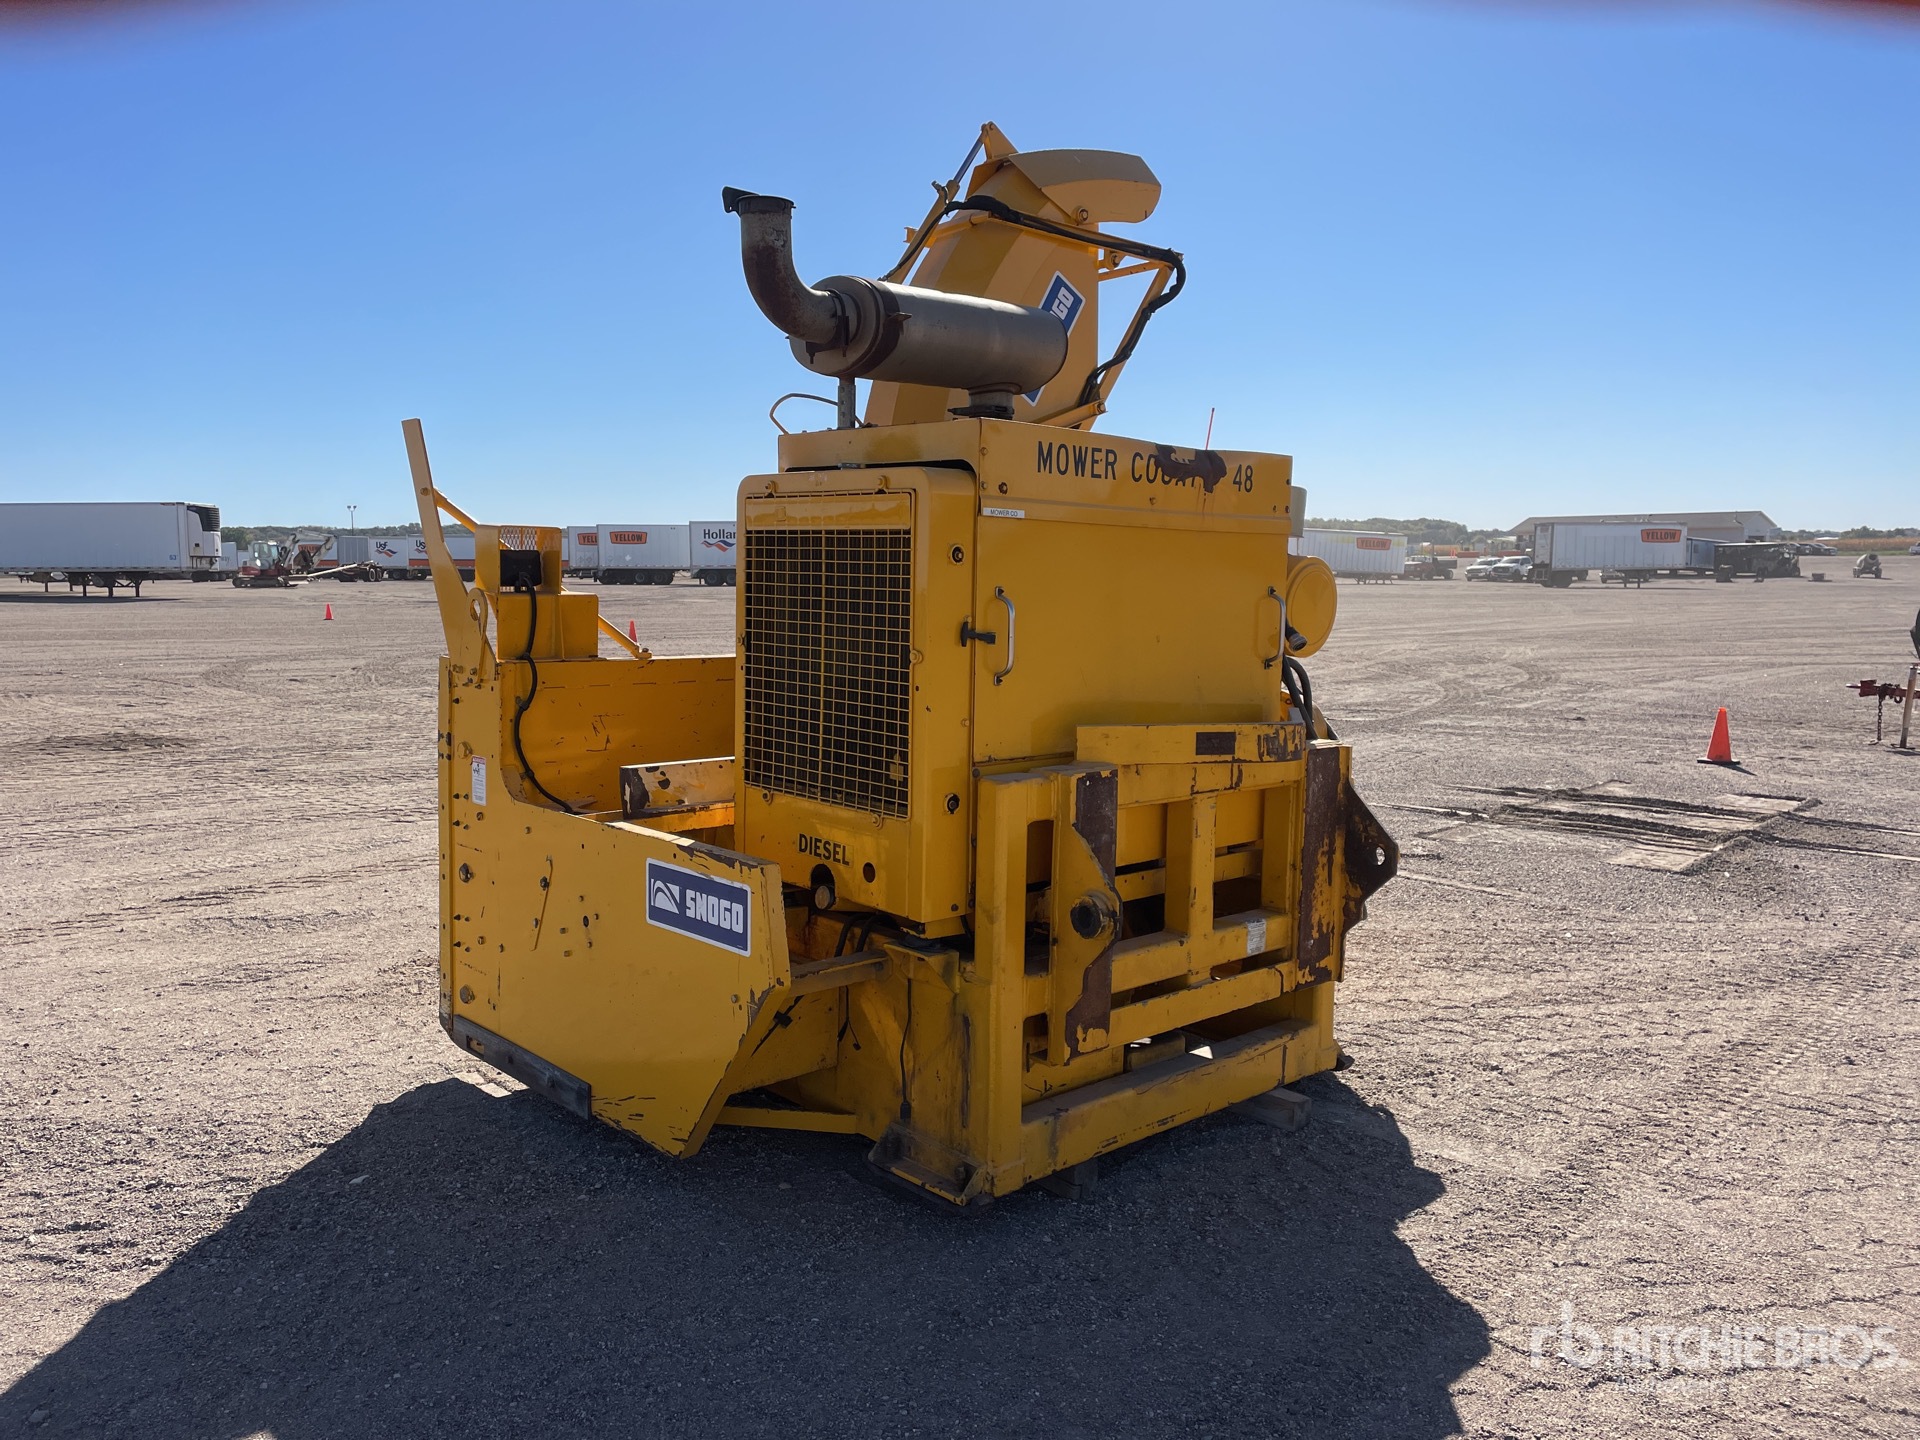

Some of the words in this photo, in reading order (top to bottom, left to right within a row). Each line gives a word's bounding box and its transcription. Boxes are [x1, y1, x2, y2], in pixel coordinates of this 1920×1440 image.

[1037, 441, 1118, 480] MOWER
[1233, 464, 1254, 493] 48
[614, 534, 642, 542] YELLOW
[1361, 540, 1386, 548] YELLOW
[1646, 532, 1676, 540] YELLOW
[798, 833, 850, 866] DIESEL
[685, 889, 744, 934] SNOGO
